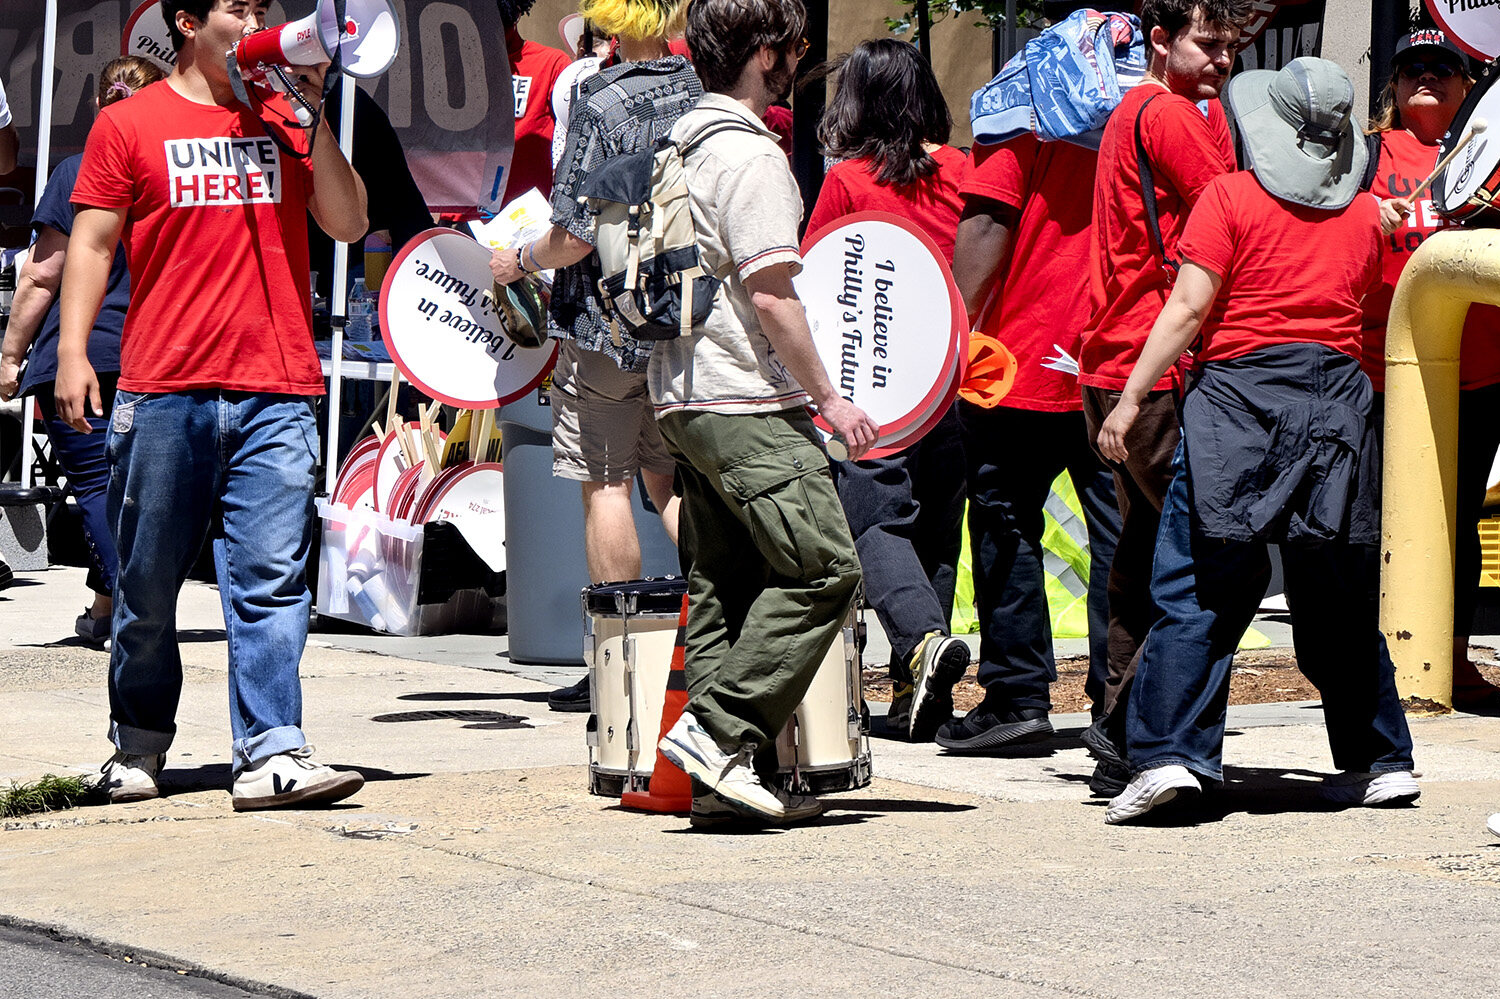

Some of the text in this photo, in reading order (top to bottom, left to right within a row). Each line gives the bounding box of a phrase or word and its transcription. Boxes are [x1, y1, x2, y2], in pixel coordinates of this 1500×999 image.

[296, 28, 311, 41] PYLE
[1411, 39, 1433, 47] LOCAL
[170, 140, 276, 169] UNITE
[175, 170, 274, 203] HERE!
[415, 259, 480, 308] Future.
[836, 233, 866, 324] Philly's
[417, 297, 439, 321] in
[872, 259, 896, 390] I believe in
[439, 309, 506, 354] believe
